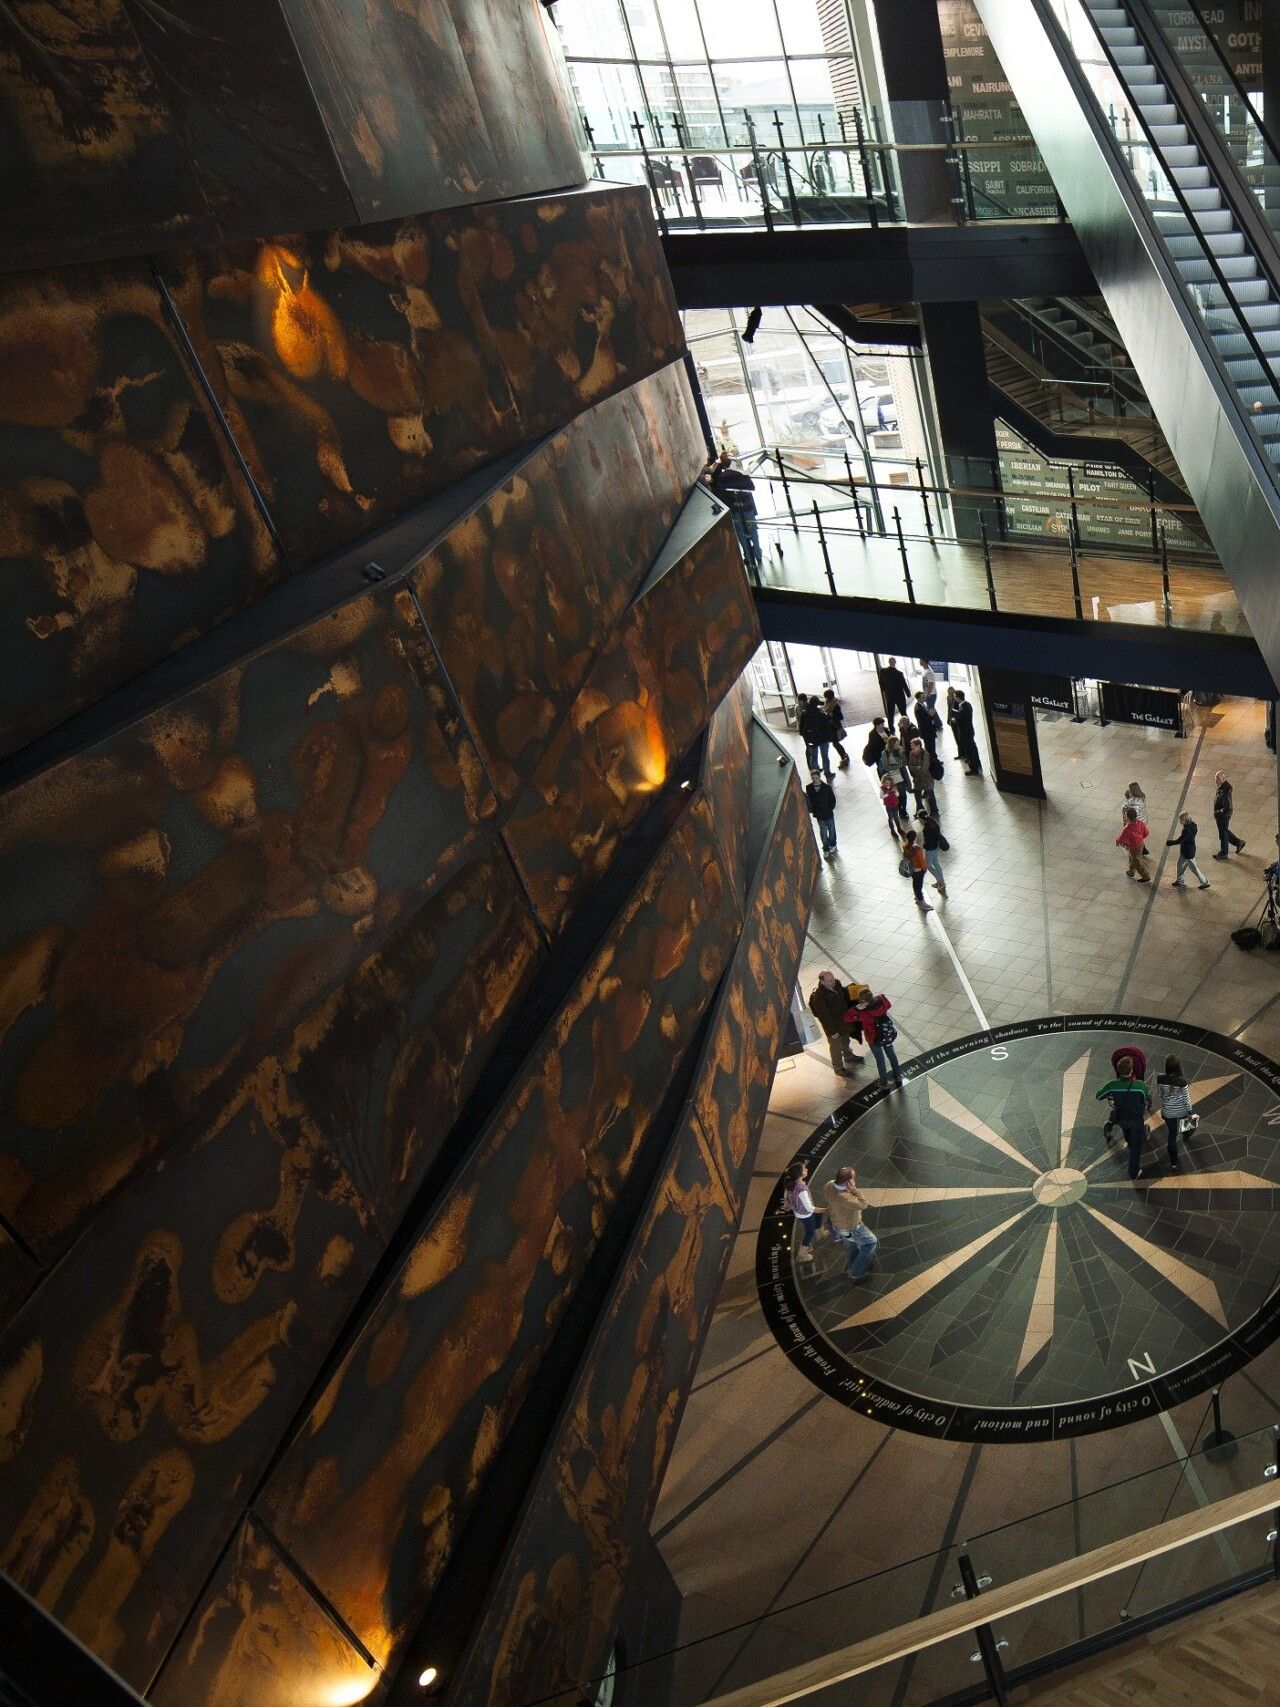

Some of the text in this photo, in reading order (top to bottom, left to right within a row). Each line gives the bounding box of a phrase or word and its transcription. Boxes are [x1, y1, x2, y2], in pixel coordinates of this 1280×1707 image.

[1201, 10, 1224, 24] EAD
[1177, 36, 1219, 50] MYST
[943, 47, 984, 58] EMPLEMORE
[972, 82, 1013, 93] NAIRUN
[1009, 161, 1047, 173] SOBRAO
[1007, 205, 1059, 216] LANCASHIR
[1079, 483, 1101, 492] PILOT
[1120, 482, 1137, 490] QUEEN
[1021, 504, 1050, 514] CASTILIAN
[1150, 518, 1182, 531] ECIFE
[1050, 1021, 1062, 1029] the
[1068, 1019, 1092, 1027] sound
[1094, 1019, 1103, 1027] of
[925, 1055, 935, 1064] of
[936, 1050, 951, 1060] the
[995, 1027, 1029, 1039] shadows
[990, 1046, 1009, 1061] S
[788, 1322, 806, 1342] dawn
[803, 1344, 817, 1358] the
[814, 1355, 836, 1376] From
[1126, 1352, 1156, 1381] N
[866, 1392, 901, 1411] endless
[898, 1405, 913, 1416] of
[914, 1408, 934, 1423] city
[974, 1396, 1151, 1431] O city of sound and motion!
[935, 1416, 946, 1426] O
